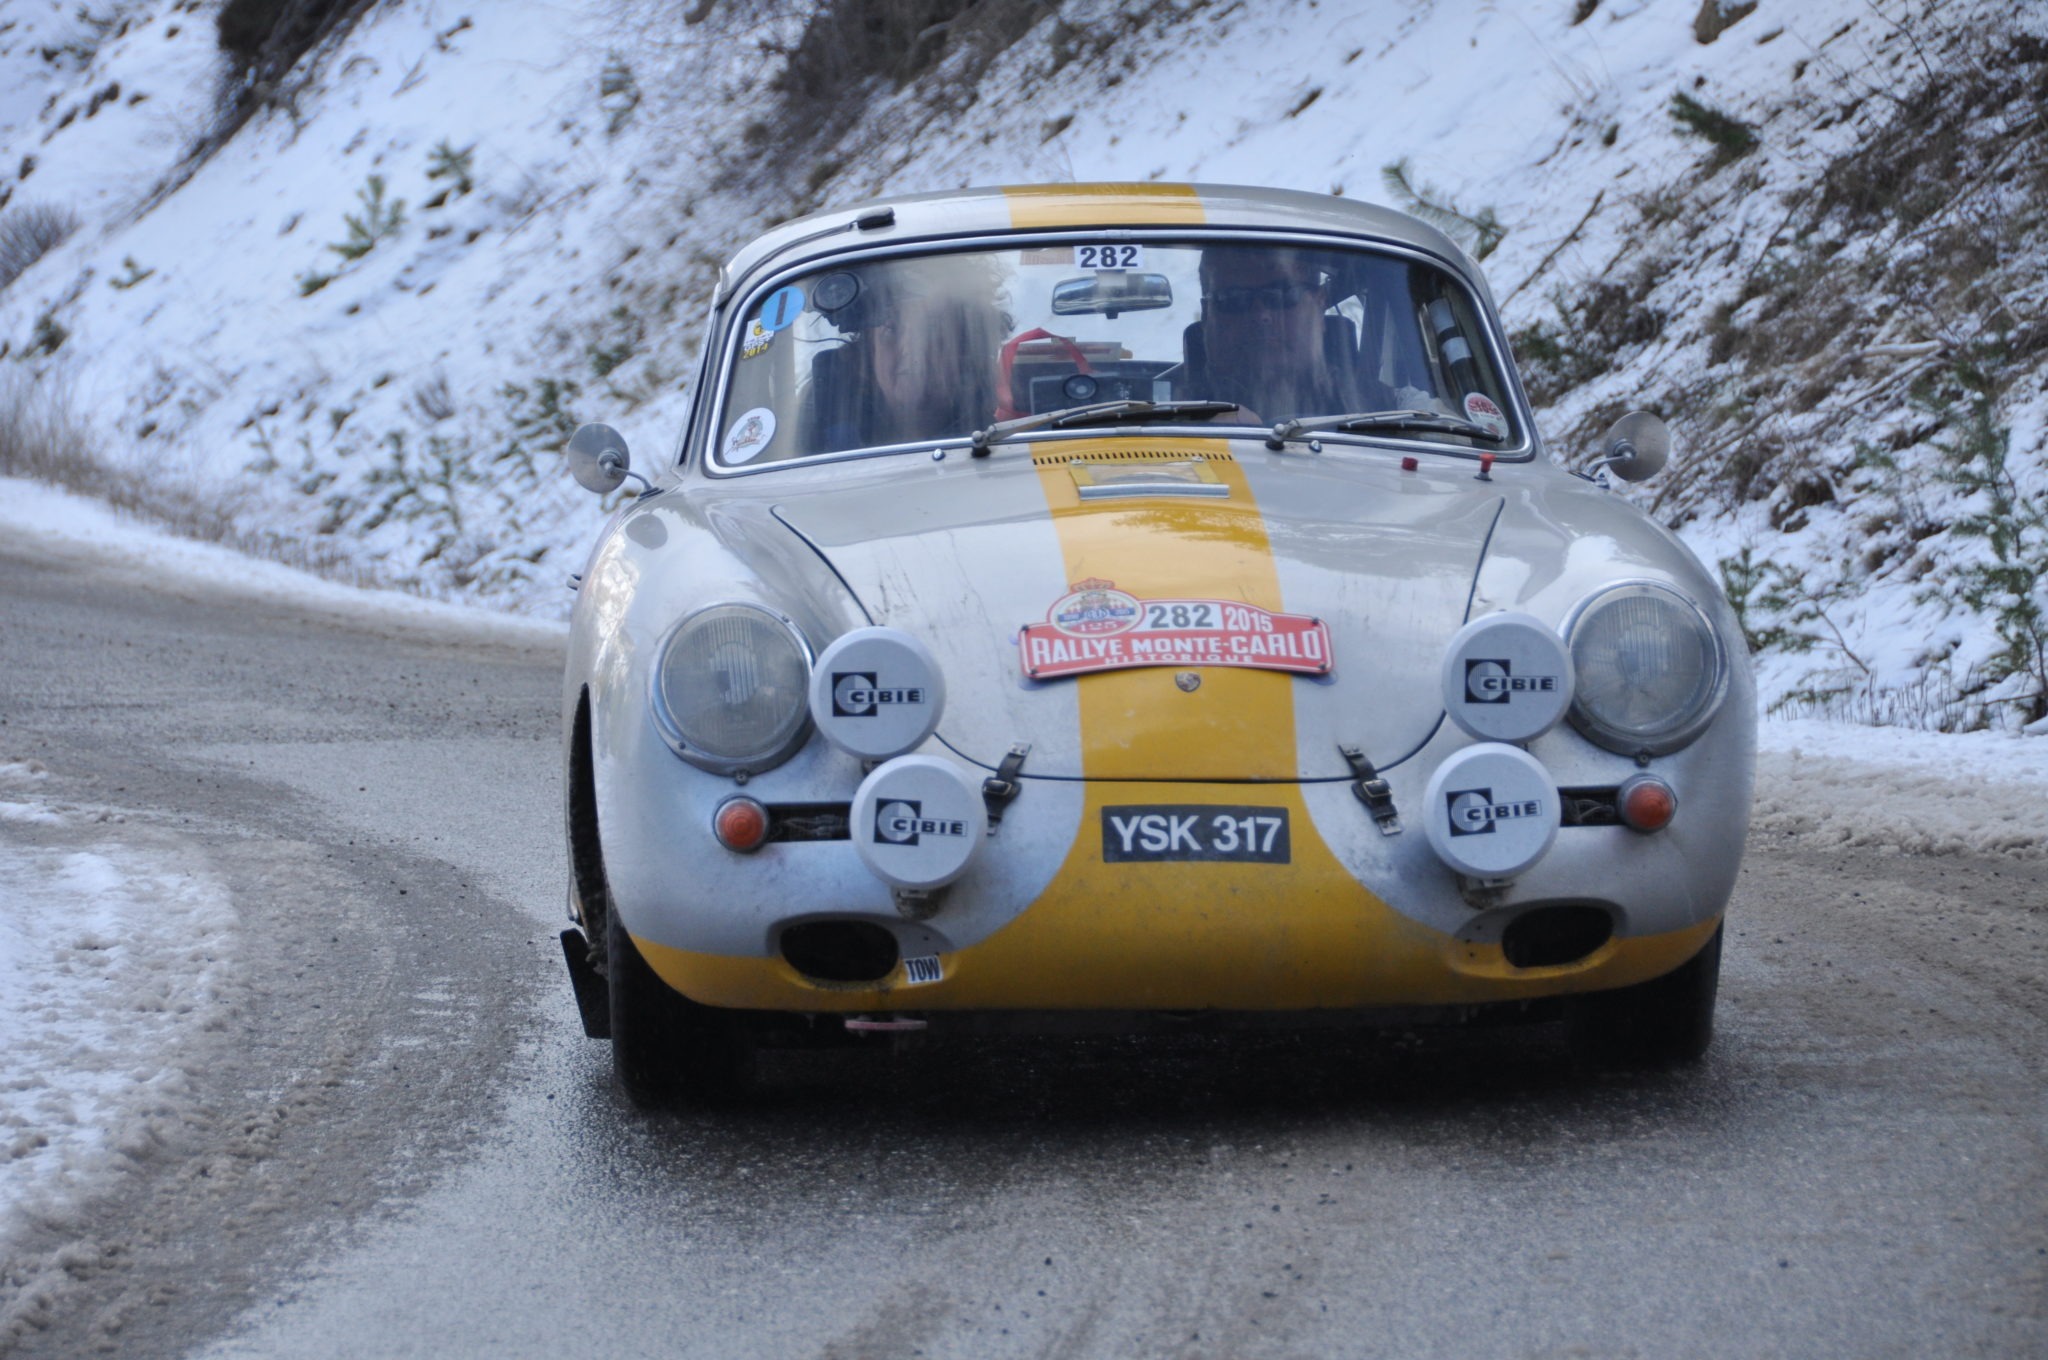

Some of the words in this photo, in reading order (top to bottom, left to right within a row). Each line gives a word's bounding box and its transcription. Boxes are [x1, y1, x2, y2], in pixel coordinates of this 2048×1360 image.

[1080, 246, 1138, 268] 282
[1148, 604, 1214, 629] 282
[1226, 606, 1274, 633] 2015
[1031, 637, 1123, 666] RALLYE
[1131, 630, 1322, 660] MONTE-CARLO
[1105, 654, 1253, 665] HISTORIQUE
[1110, 814, 1202, 852] YSK
[1212, 815, 1282, 853] 317
[905, 957, 940, 982] TOW
